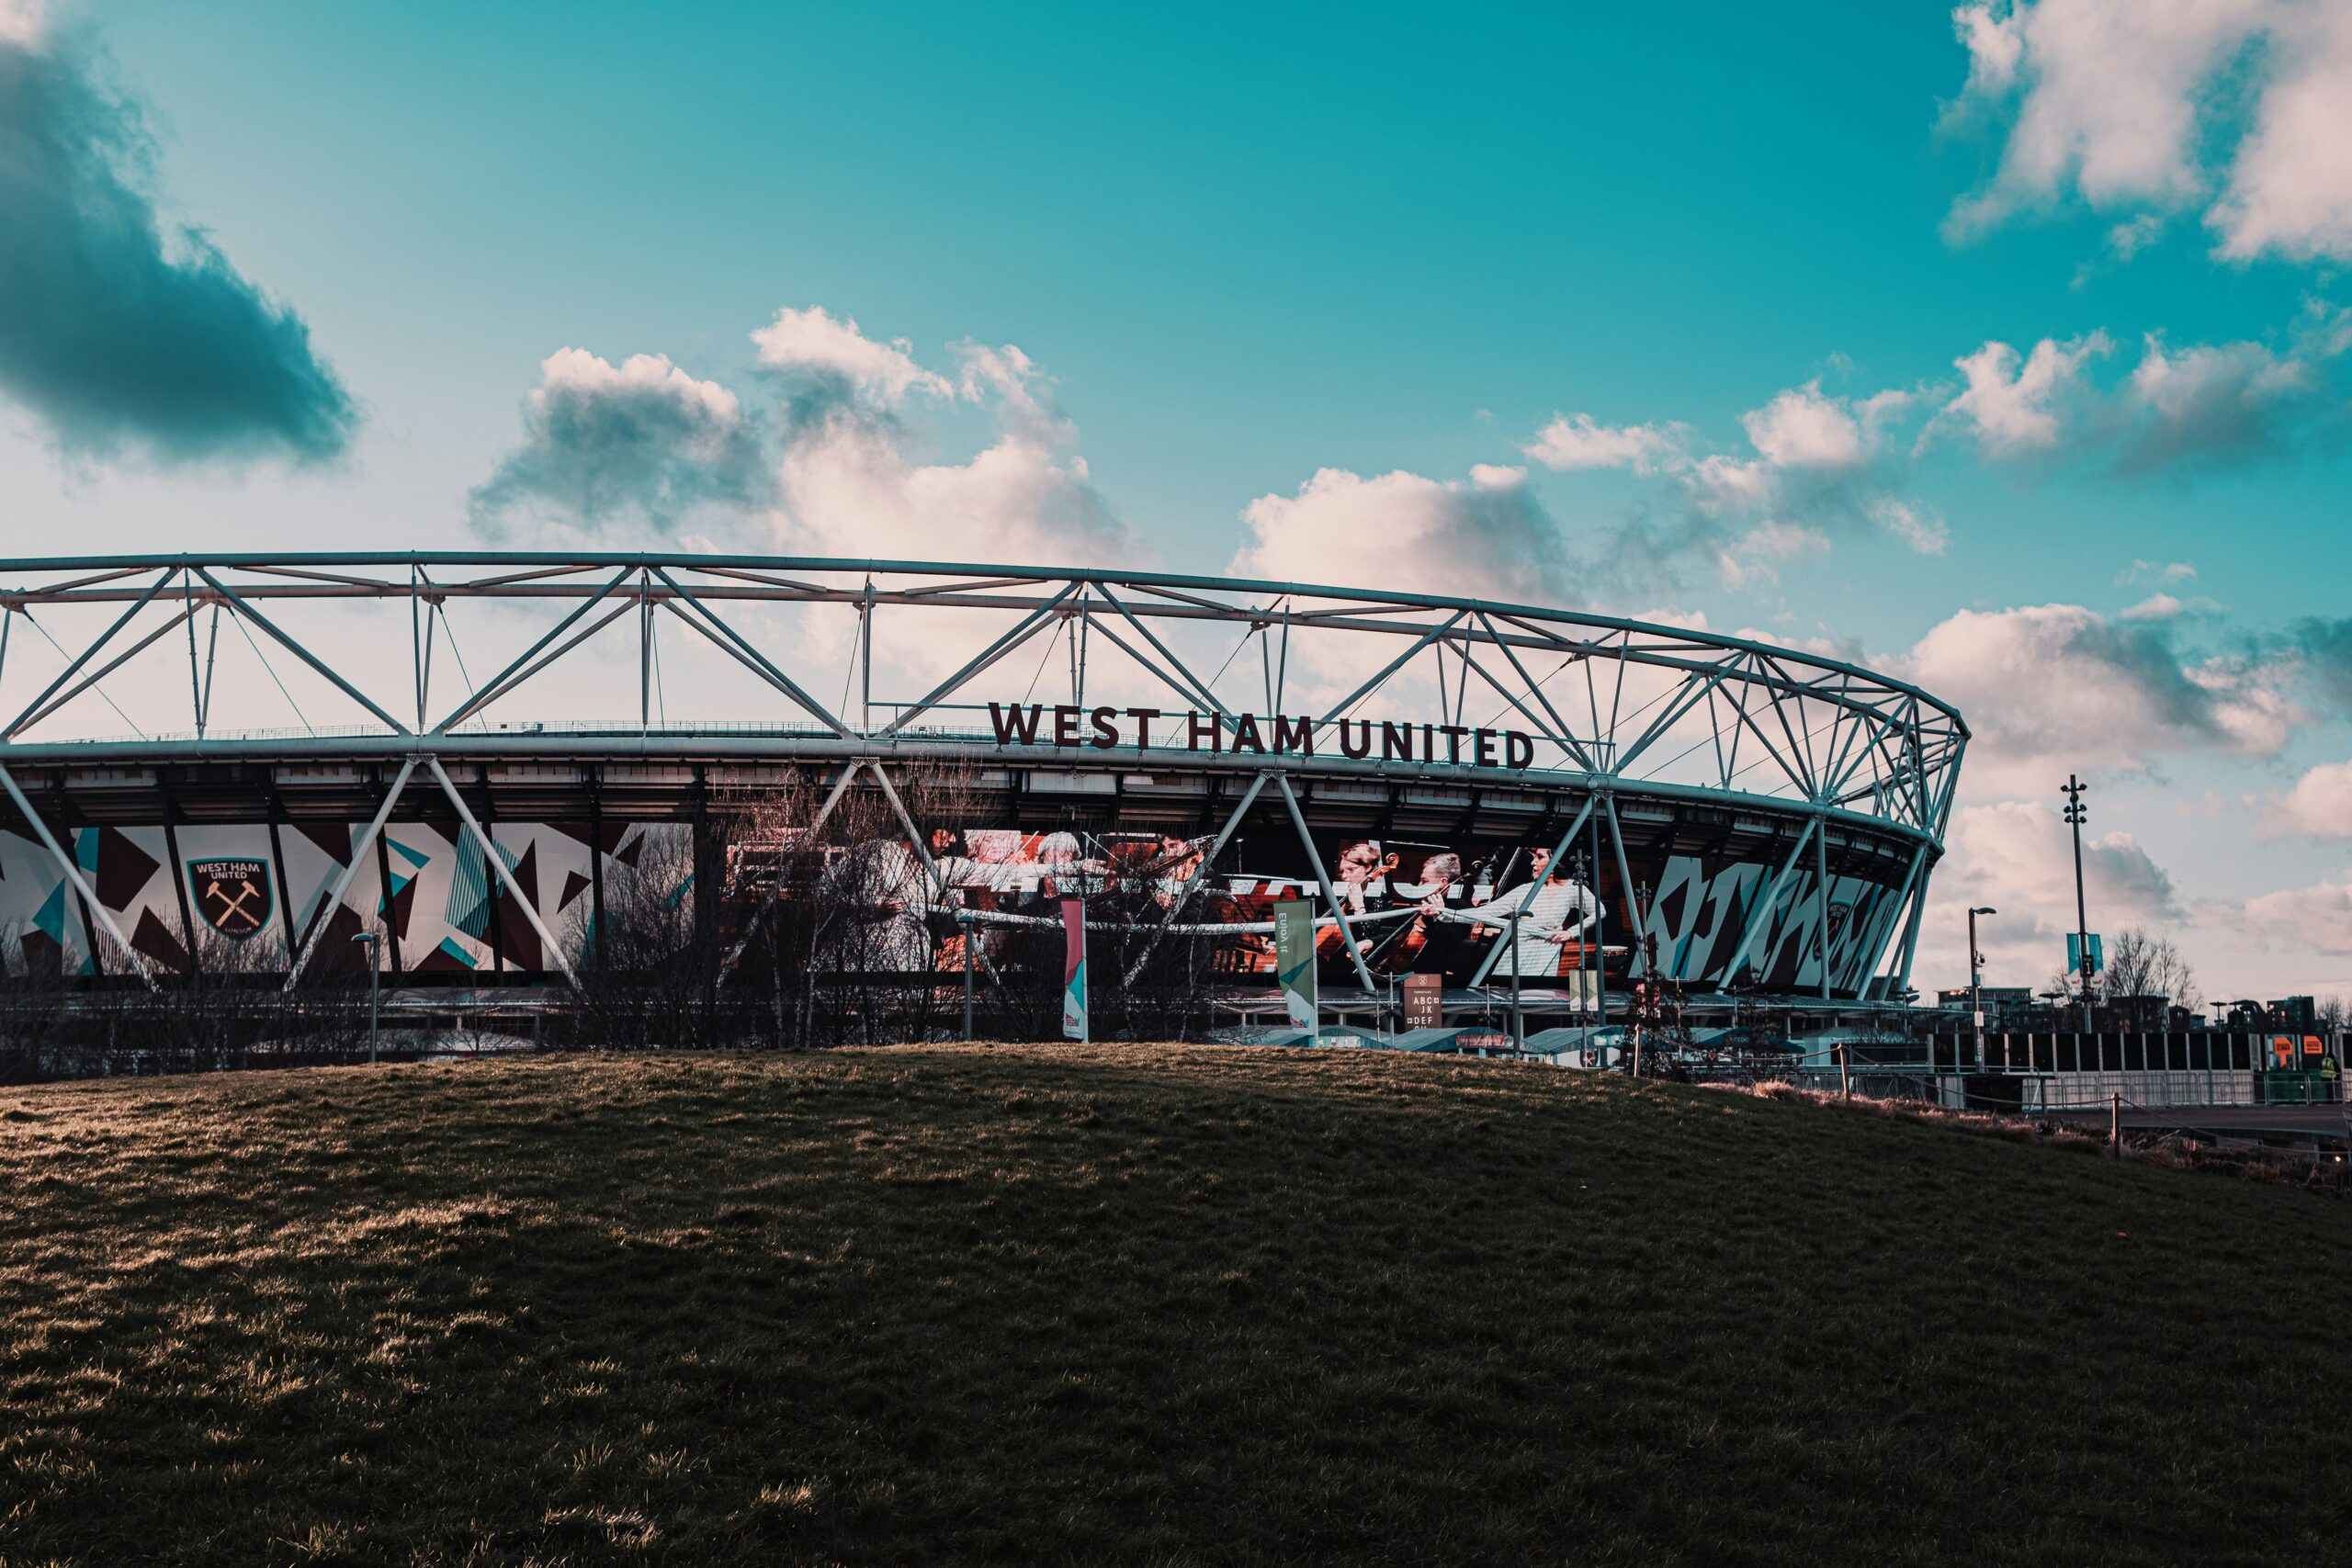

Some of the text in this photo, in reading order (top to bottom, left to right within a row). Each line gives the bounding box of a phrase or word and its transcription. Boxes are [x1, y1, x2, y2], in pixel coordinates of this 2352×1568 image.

[988, 702, 1534, 770] WEST HAM UNITED
[197, 863, 260, 874] WEST HAM
[210, 871, 248, 879] UNITED
[2086, 962, 2091, 975] 1
